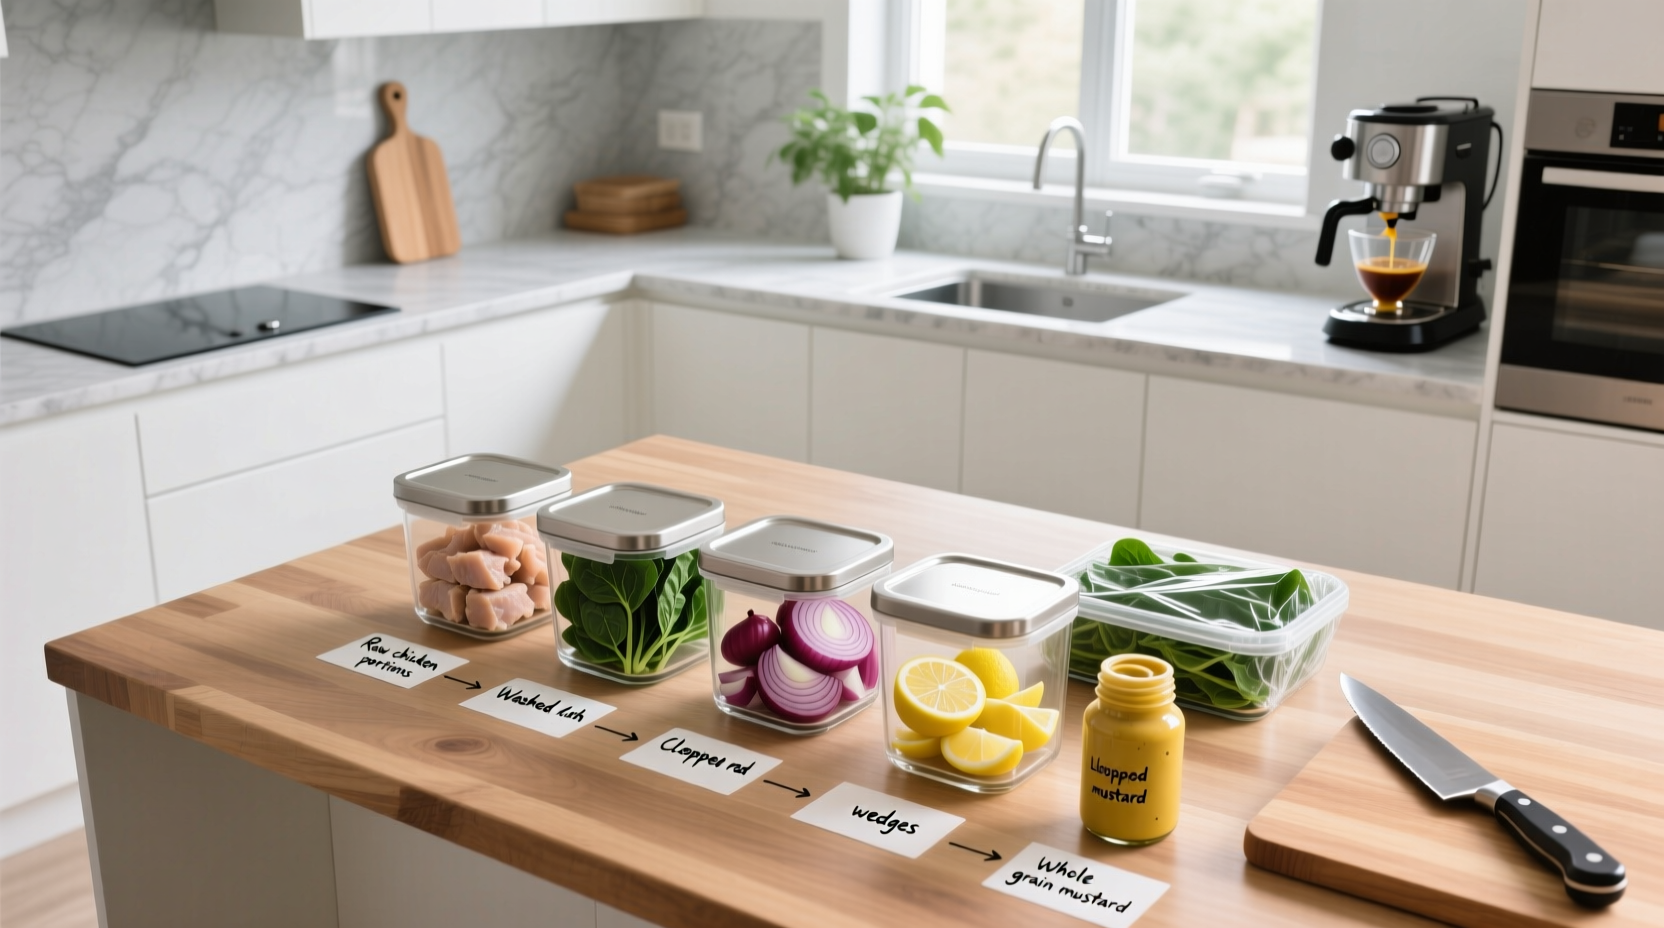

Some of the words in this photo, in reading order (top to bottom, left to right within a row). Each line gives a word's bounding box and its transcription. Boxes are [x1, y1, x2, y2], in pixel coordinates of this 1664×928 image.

[360, 637, 390, 655] Raw
[496, 685, 562, 714] Washed
[1091, 785, 1147, 804] mustard
[851, 805, 920, 835] wedges
[1037, 856, 1094, 885] Whole
[1004, 871, 1054, 891] grain
[1058, 886, 1133, 914] mustard
